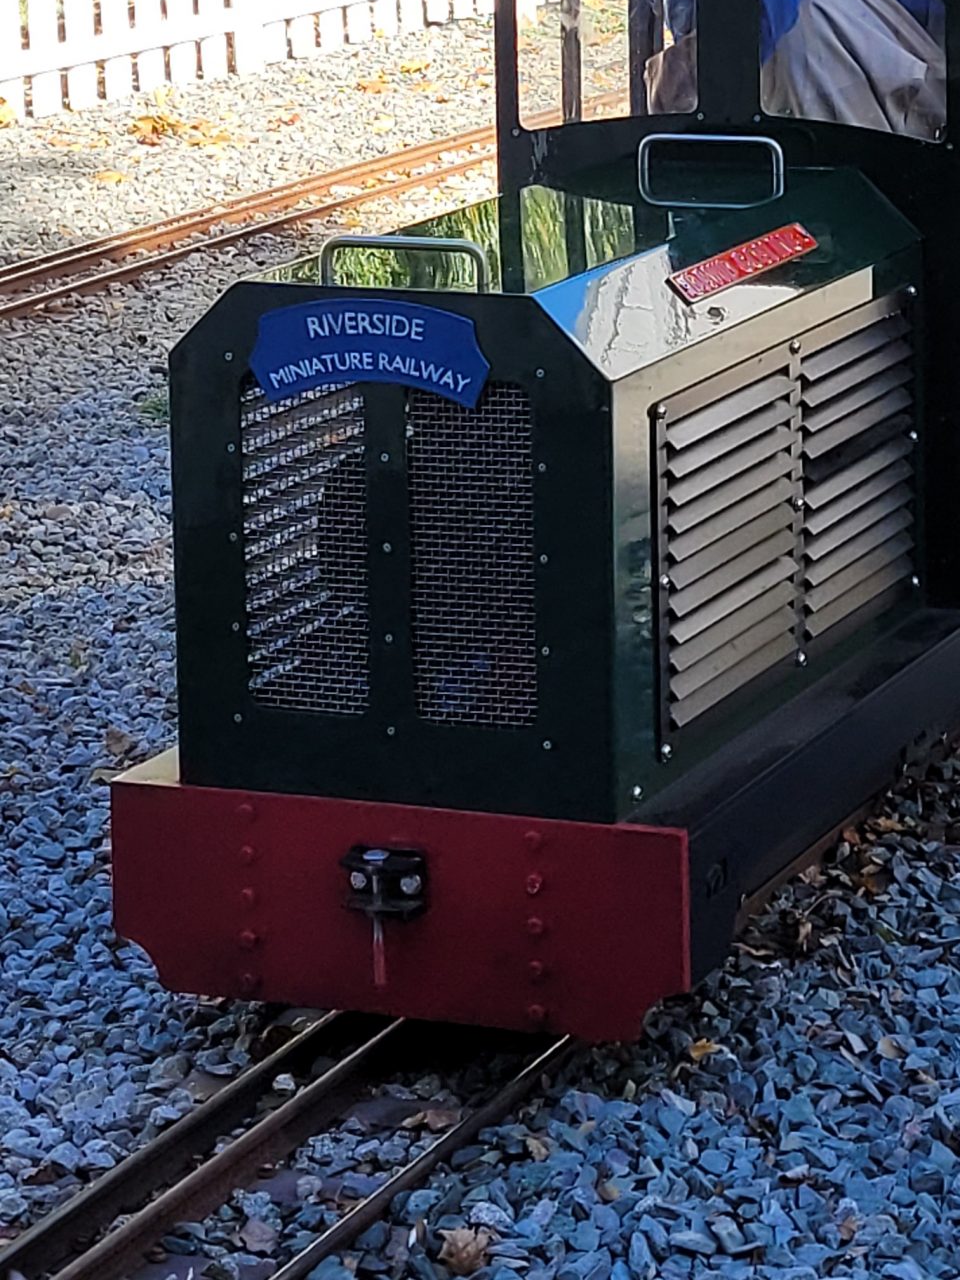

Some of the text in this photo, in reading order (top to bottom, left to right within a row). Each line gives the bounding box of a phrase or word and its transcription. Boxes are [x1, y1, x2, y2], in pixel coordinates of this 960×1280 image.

[306, 312, 424, 341] RIVERSIDE
[268, 352, 471, 394] MINIATURE RAILWAY
